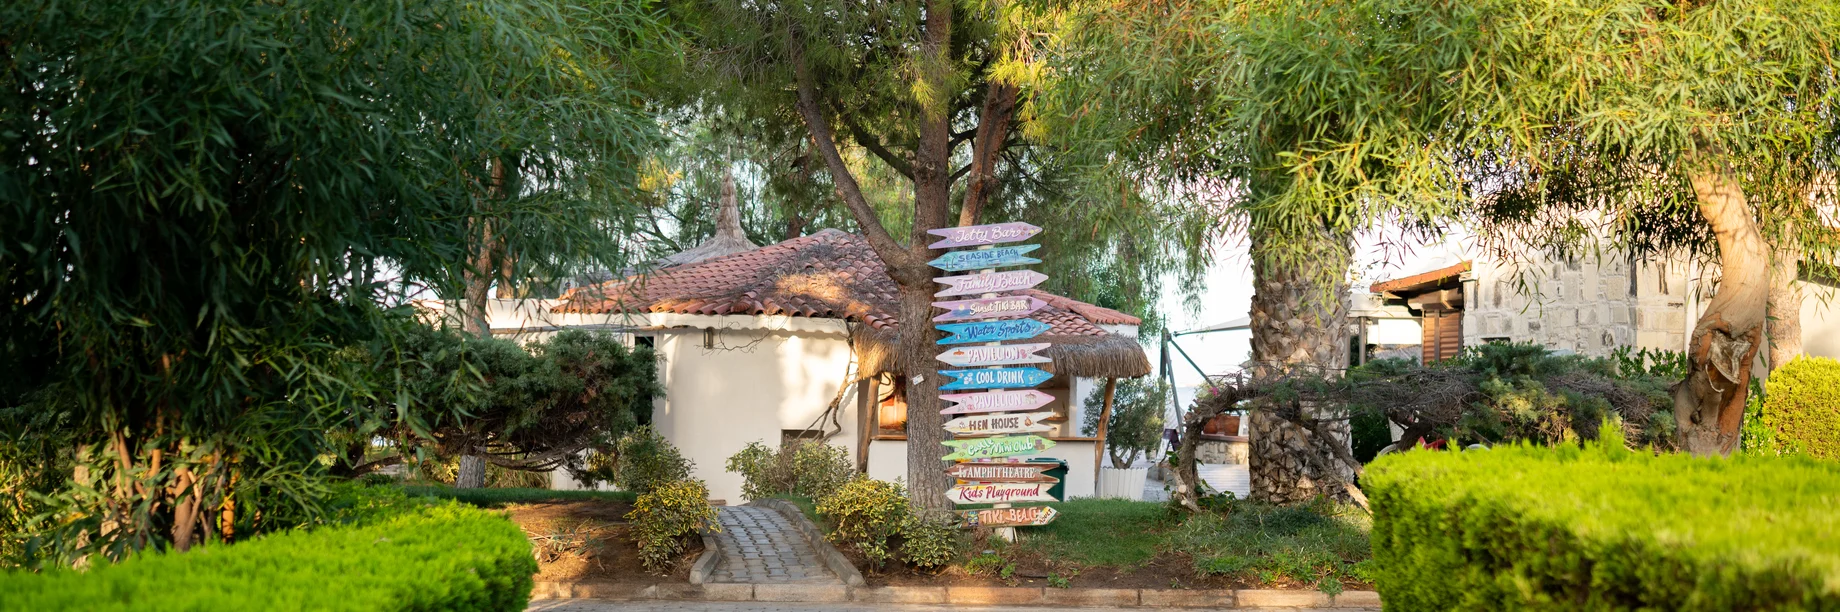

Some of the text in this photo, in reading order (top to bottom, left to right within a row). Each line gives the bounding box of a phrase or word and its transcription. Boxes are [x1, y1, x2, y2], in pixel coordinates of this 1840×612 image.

[956, 226, 1021, 242] Jetty Bar
[959, 248, 1018, 262] SEASIDE BEACH
[954, 272, 1031, 292] Family Beach
[970, 300, 1028, 315] Sunset TIKI BAR
[964, 320, 1030, 339] Water Sports
[967, 346, 1020, 363] PAVILLION
[976, 370, 1024, 384] COOL DRINK
[972, 393, 1022, 410] PAVILLION
[969, 416, 1018, 430] HEN HOUSE
[990, 442, 1012, 454] Mini
[1014, 436, 1033, 452] Club
[967, 466, 1036, 478] AMPHITHEATRE
[960, 484, 1040, 502] Kids Playground
[1009, 507, 1040, 522] BEACH
[1040, 508, 1052, 524] ADULT
